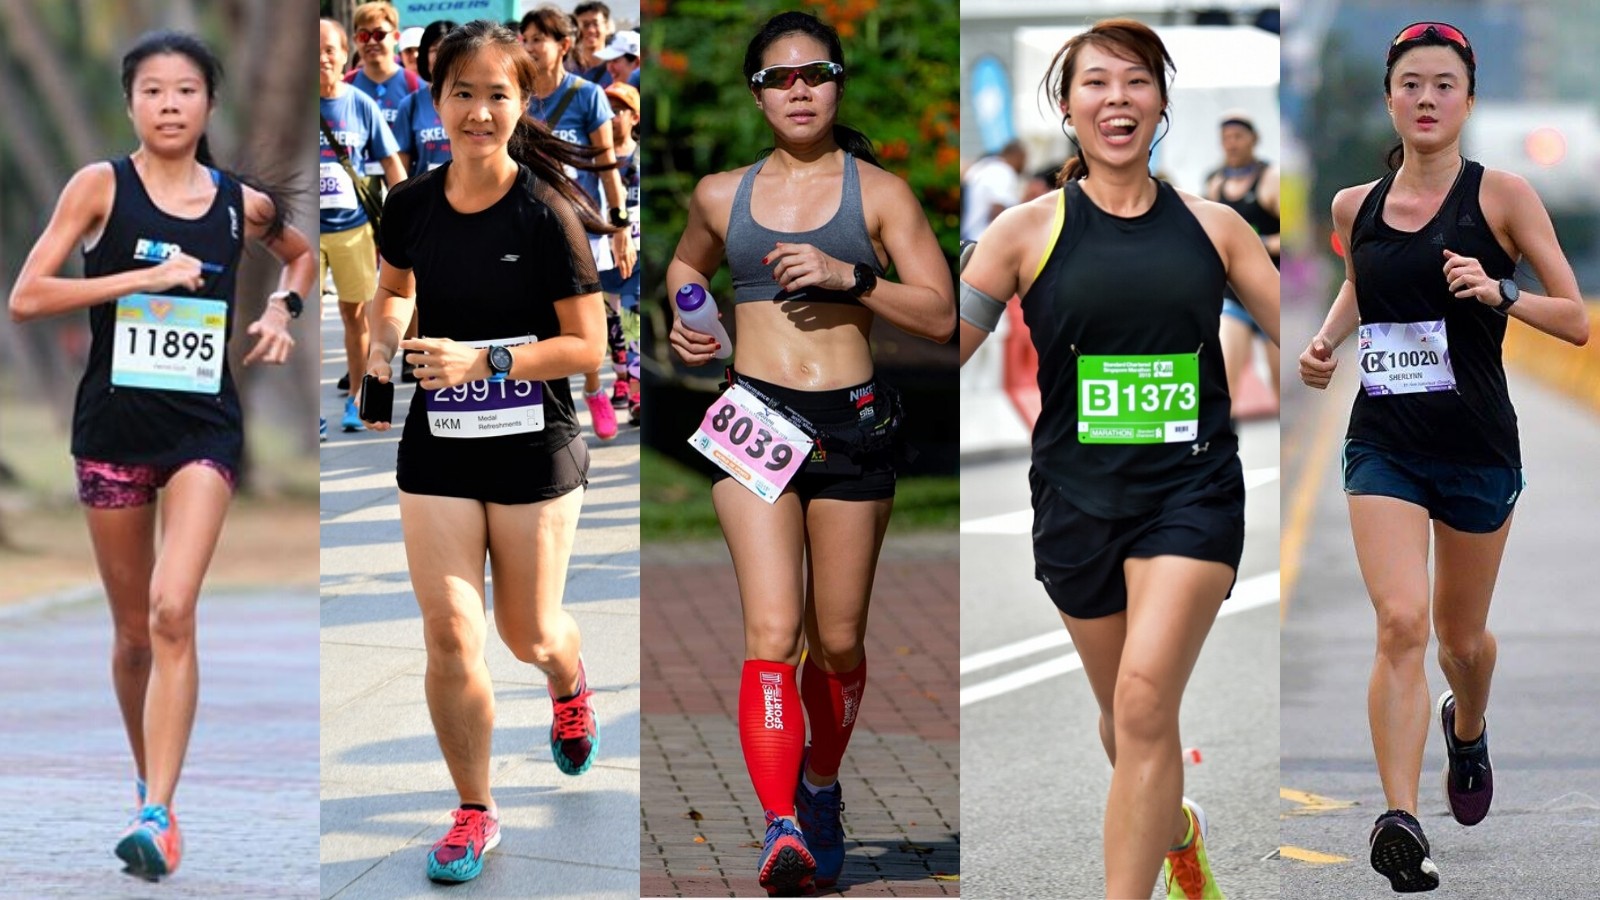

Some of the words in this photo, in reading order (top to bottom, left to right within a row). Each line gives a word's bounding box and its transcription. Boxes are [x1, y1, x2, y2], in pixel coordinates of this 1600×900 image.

[407, 0, 489, 13] SKECHERS
[128, 327, 214, 361] 11895
[1367, 353, 1379, 372] C
[1389, 350, 1439, 368] 10020
[1388, 372, 1423, 381] SHERLYNN
[434, 379, 532, 402] 29915
[850, 384, 874, 402] NIKE
[1089, 384, 1112, 411] B
[1122, 382, 1196, 412] 1373
[434, 418, 461, 430] 4KM
[477, 414, 497, 422] Medal
[478, 420, 522, 430] Refreshments
[712, 404, 793, 472] 8039
[1092, 429, 1132, 437] MARATHON
[773, 696, 784, 730] SPORT
